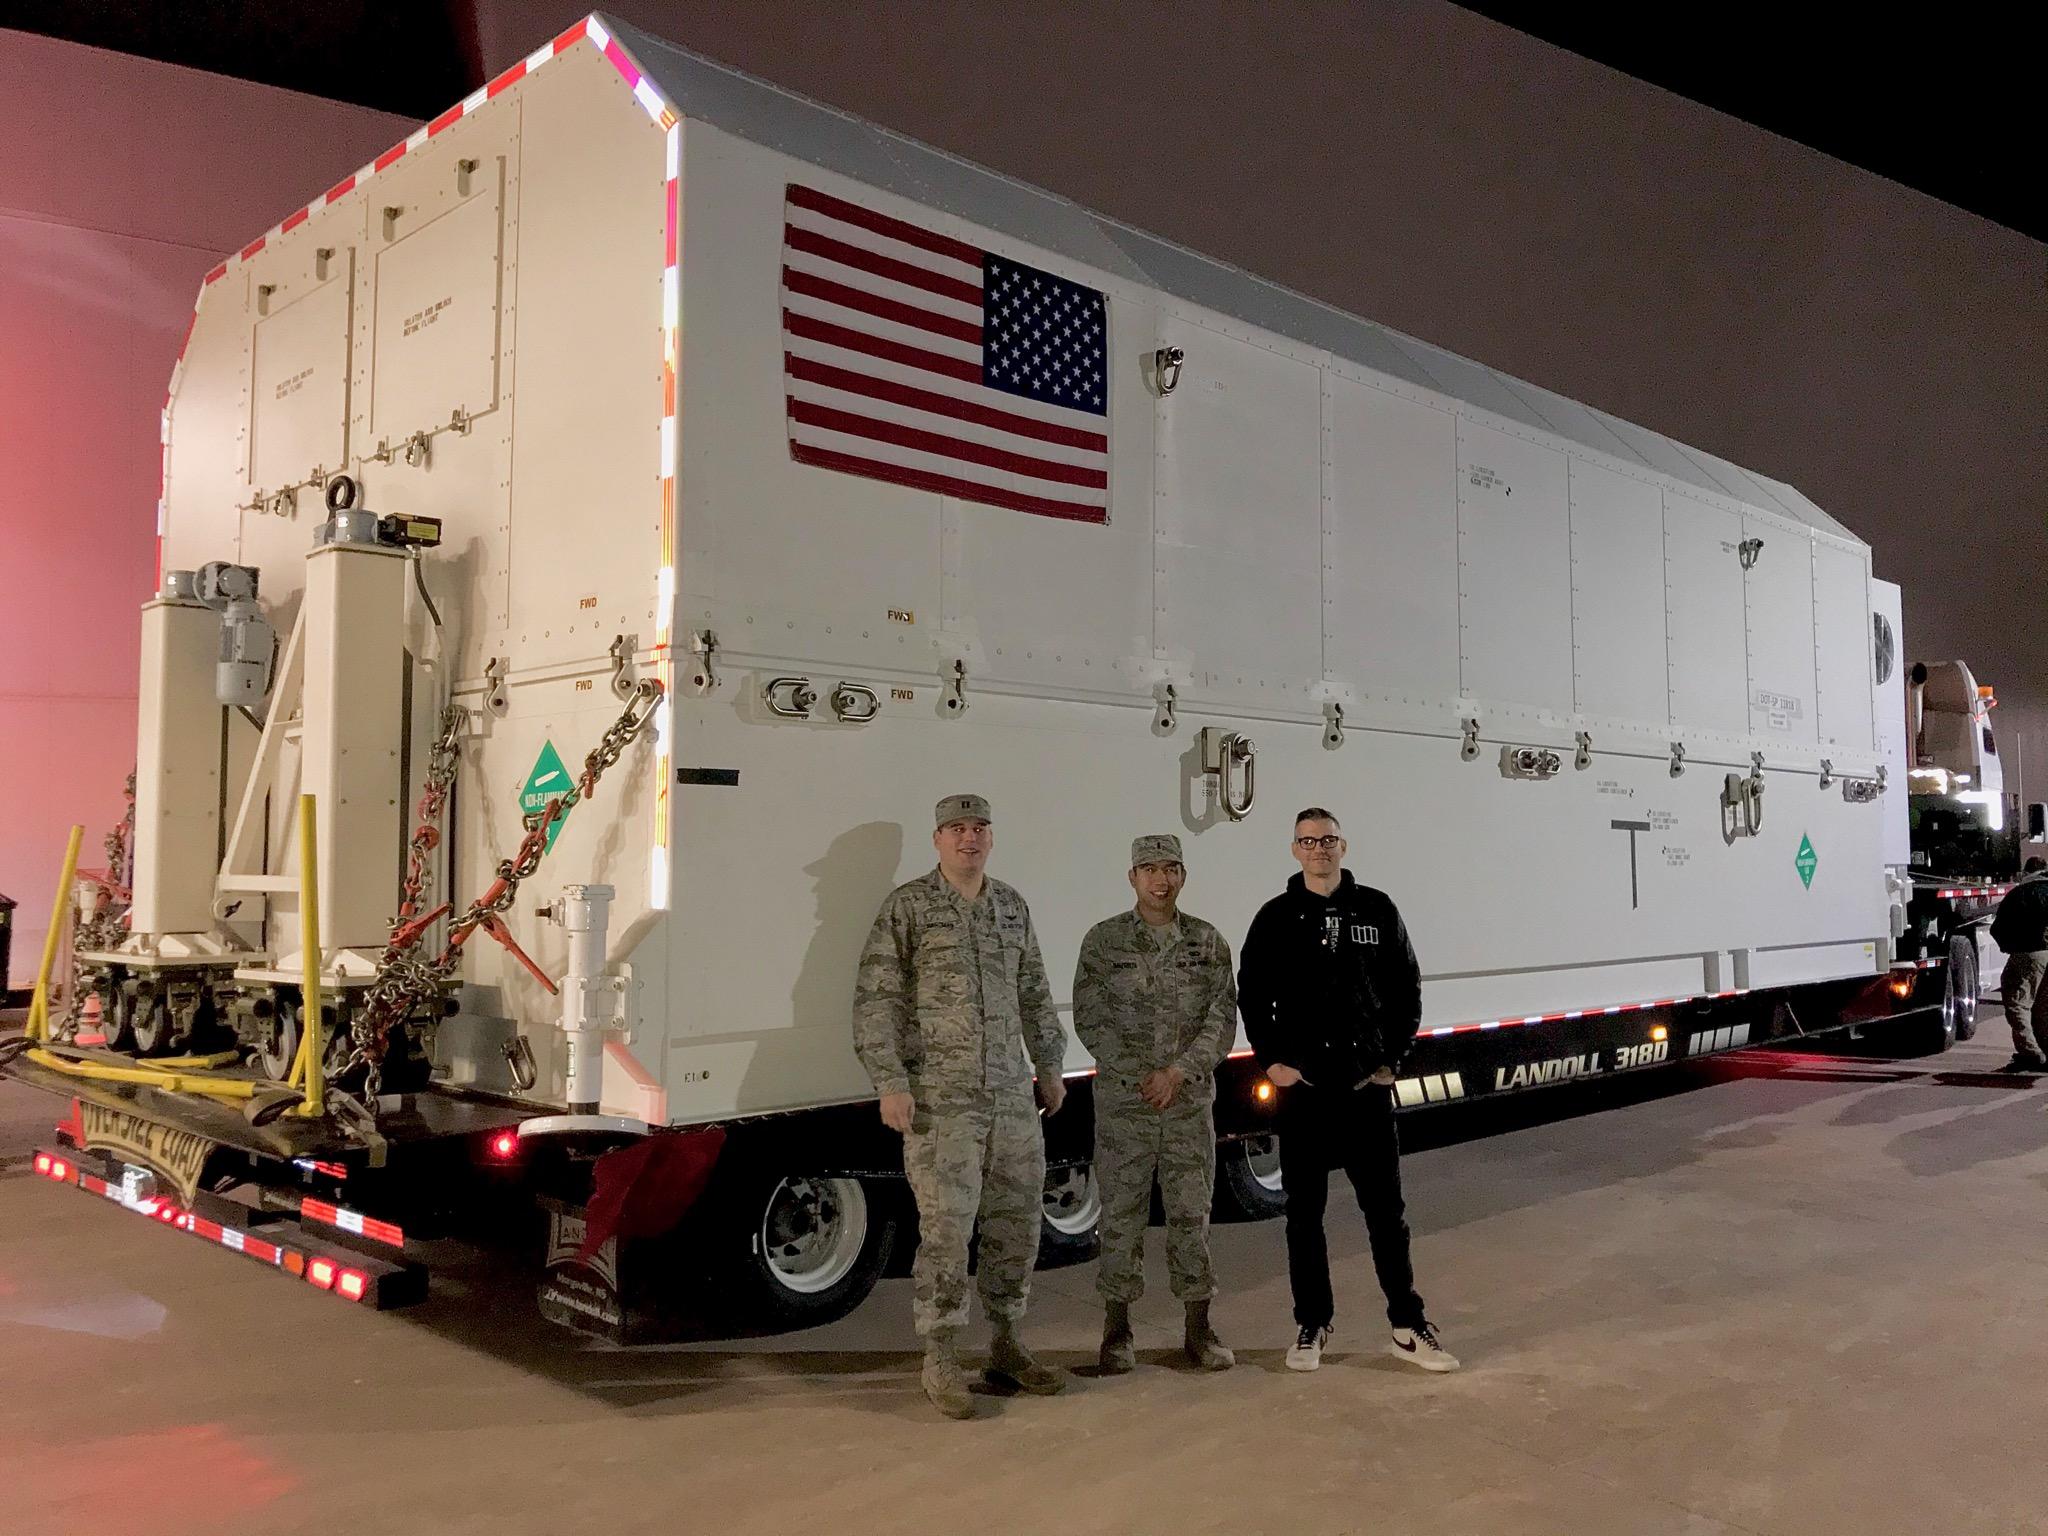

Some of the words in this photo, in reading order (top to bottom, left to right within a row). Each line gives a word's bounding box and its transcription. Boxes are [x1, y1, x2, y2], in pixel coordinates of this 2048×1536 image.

[580, 597, 597, 609] FWD
[575, 679, 593, 691] FWD
[891, 688, 914, 700] FWD
[1494, 1052, 1603, 1091] LANDOLL
[1614, 1041, 1669, 1070] 318D
